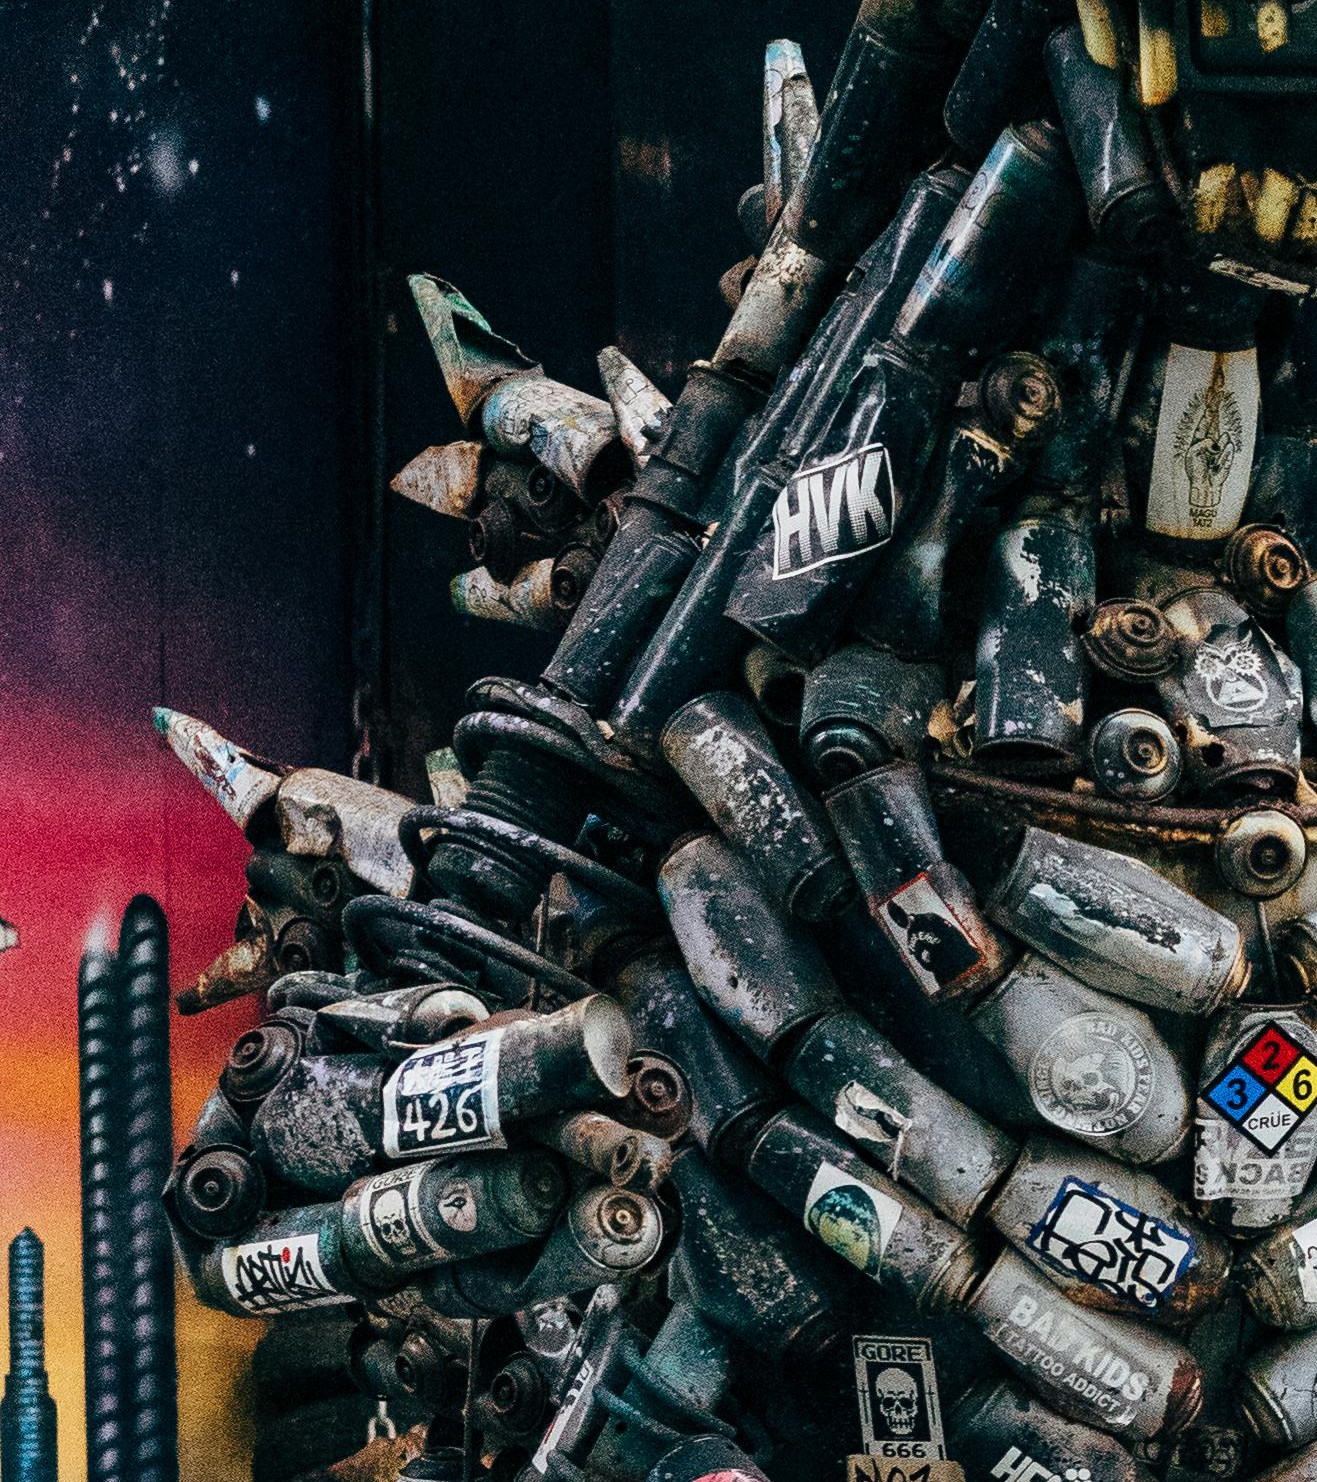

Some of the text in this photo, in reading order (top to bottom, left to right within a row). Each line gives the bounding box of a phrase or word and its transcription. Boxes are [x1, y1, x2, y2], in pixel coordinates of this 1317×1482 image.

[777, 450, 887, 569] HVK
[1262, 1040, 1281, 1071] 2
[1226, 1069, 1313, 1110] 3 6
[402, 1088, 478, 1142] 426
[1248, 1110, 1292, 1131] CRÜE
[861, 1341, 925, 1364] GORE
[1005, 1328, 1121, 1413] TATTOO ADDICT
[1072, 1340, 1150, 1401] KIDS
[881, 1442, 927, 1459] 666
